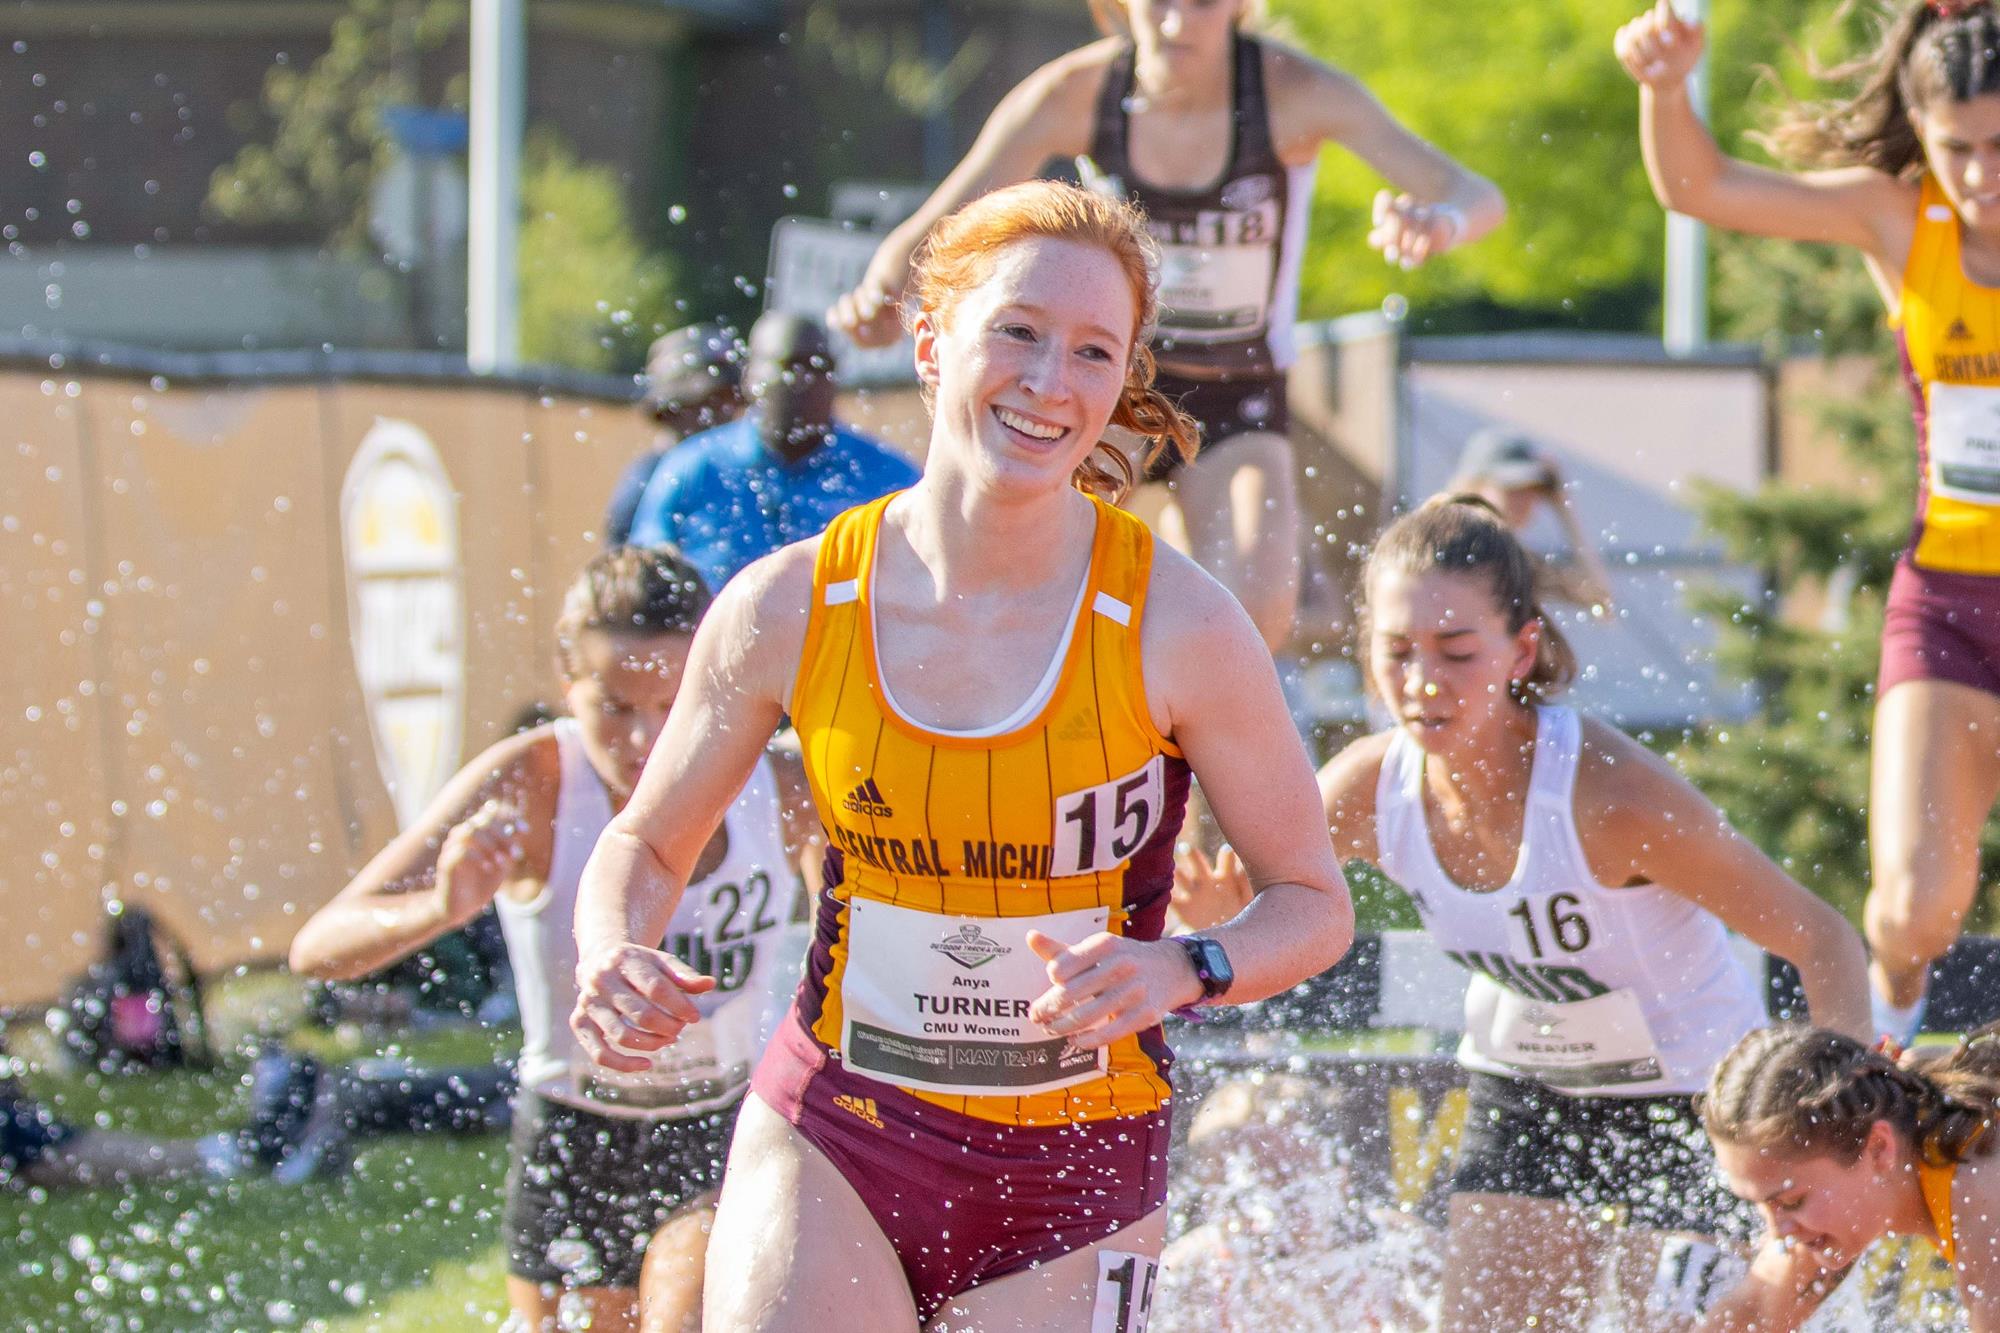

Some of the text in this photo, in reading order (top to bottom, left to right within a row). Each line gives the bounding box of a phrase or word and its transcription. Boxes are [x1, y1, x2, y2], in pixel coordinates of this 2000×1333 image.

[1213, 210, 1264, 245] 18
[843, 799, 893, 818] adidas
[1065, 771, 1149, 871] 15
[835, 824, 950, 876] CENTRAL
[709, 870, 776, 943] 22
[1508, 892, 1591, 958] 16
[952, 976, 990, 989] Anya
[913, 993, 1030, 1018] TURNER
[923, 1022, 1020, 1036] CMU Women
[955, 1048, 999, 1066] MAY
[1516, 1041, 1597, 1053] WEAVER
[832, 1096, 885, 1129] adidas
